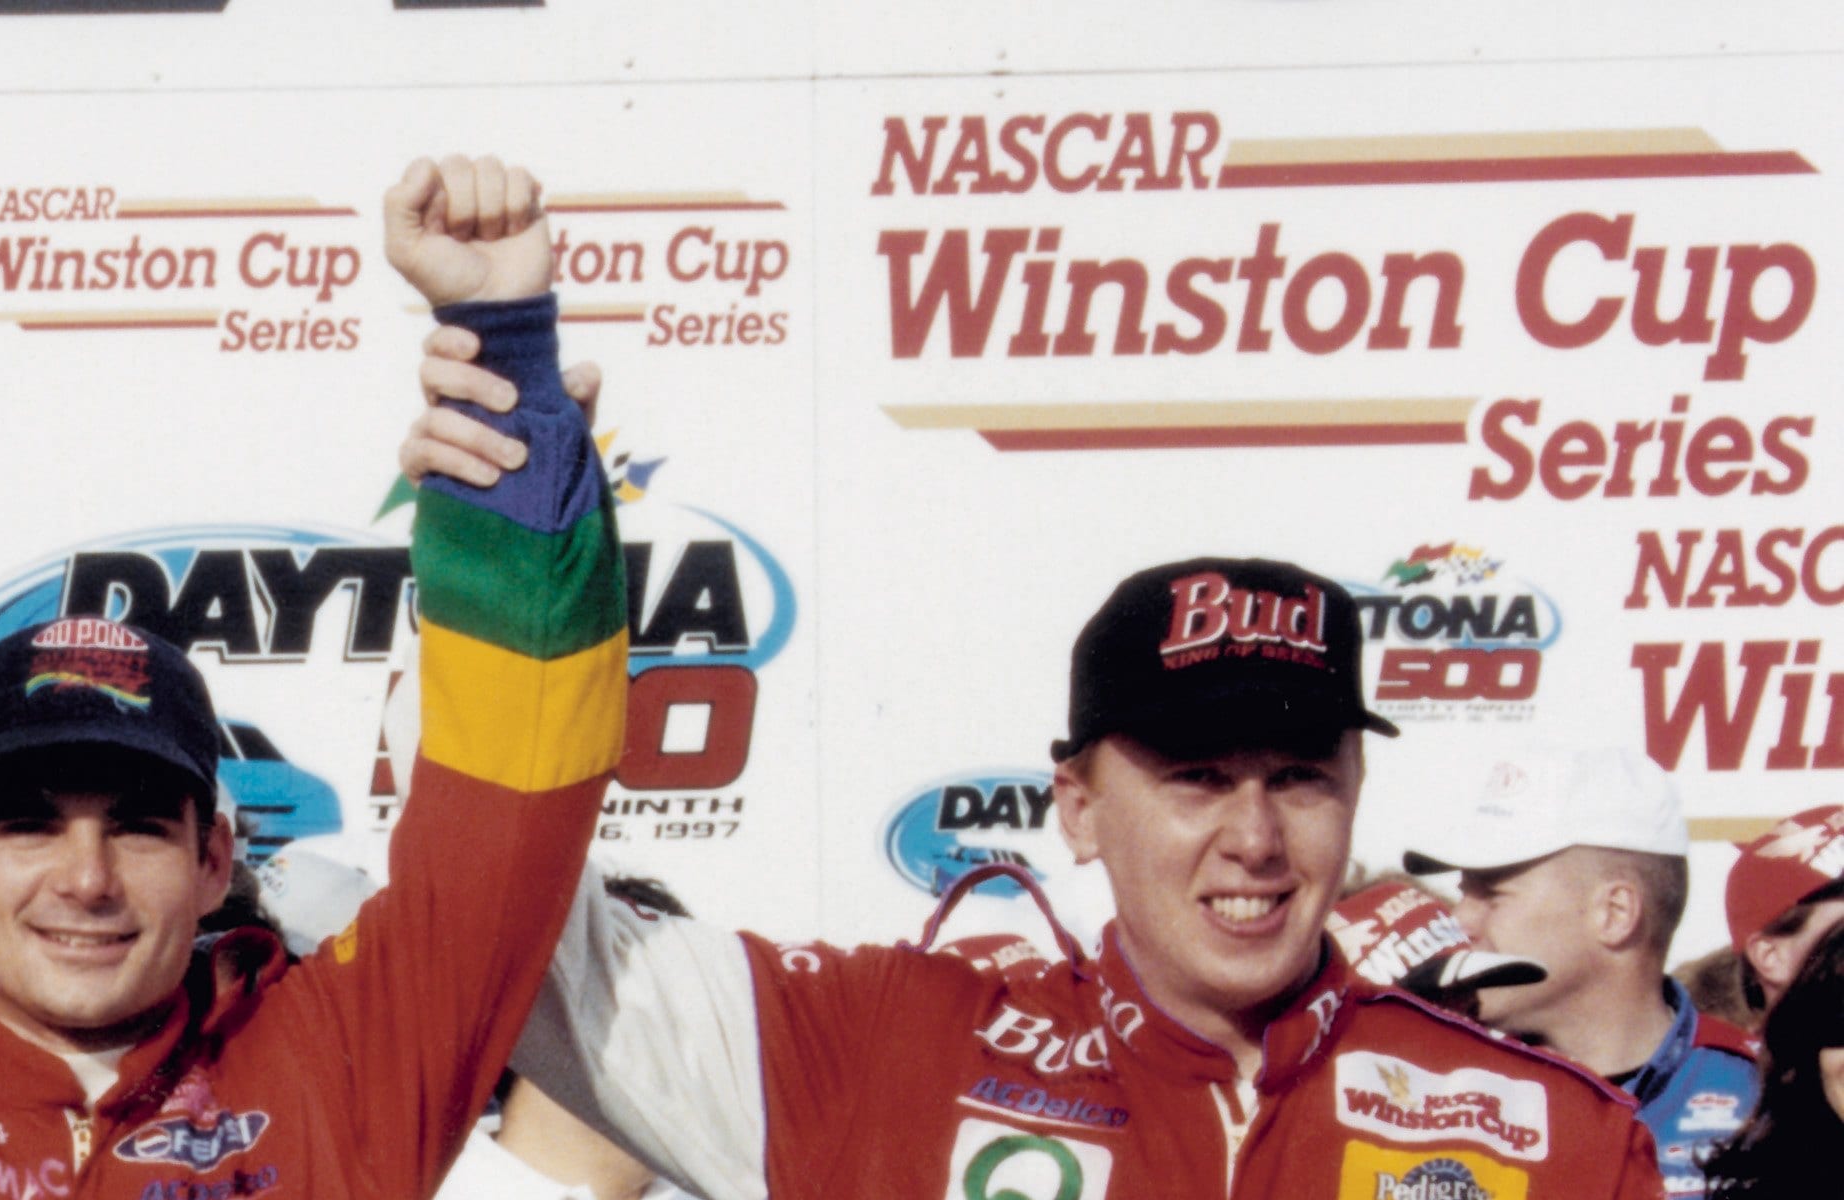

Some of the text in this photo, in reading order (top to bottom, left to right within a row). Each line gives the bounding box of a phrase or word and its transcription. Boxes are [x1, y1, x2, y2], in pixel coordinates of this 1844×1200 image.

[870, 111, 1221, 197] NASCAR
[239, 232, 360, 302] Cup
[666, 225, 790, 297] Cup
[220, 309, 361, 354] Series
[646, 303, 789, 346] Series
[877, 211, 1819, 383] Winston Cup
[1467, 394, 1816, 503] Series
[1159, 571, 1328, 654] Bud
[1375, 647, 1542, 701] 500
[1343, 1088, 1541, 1152] Winston Cup
